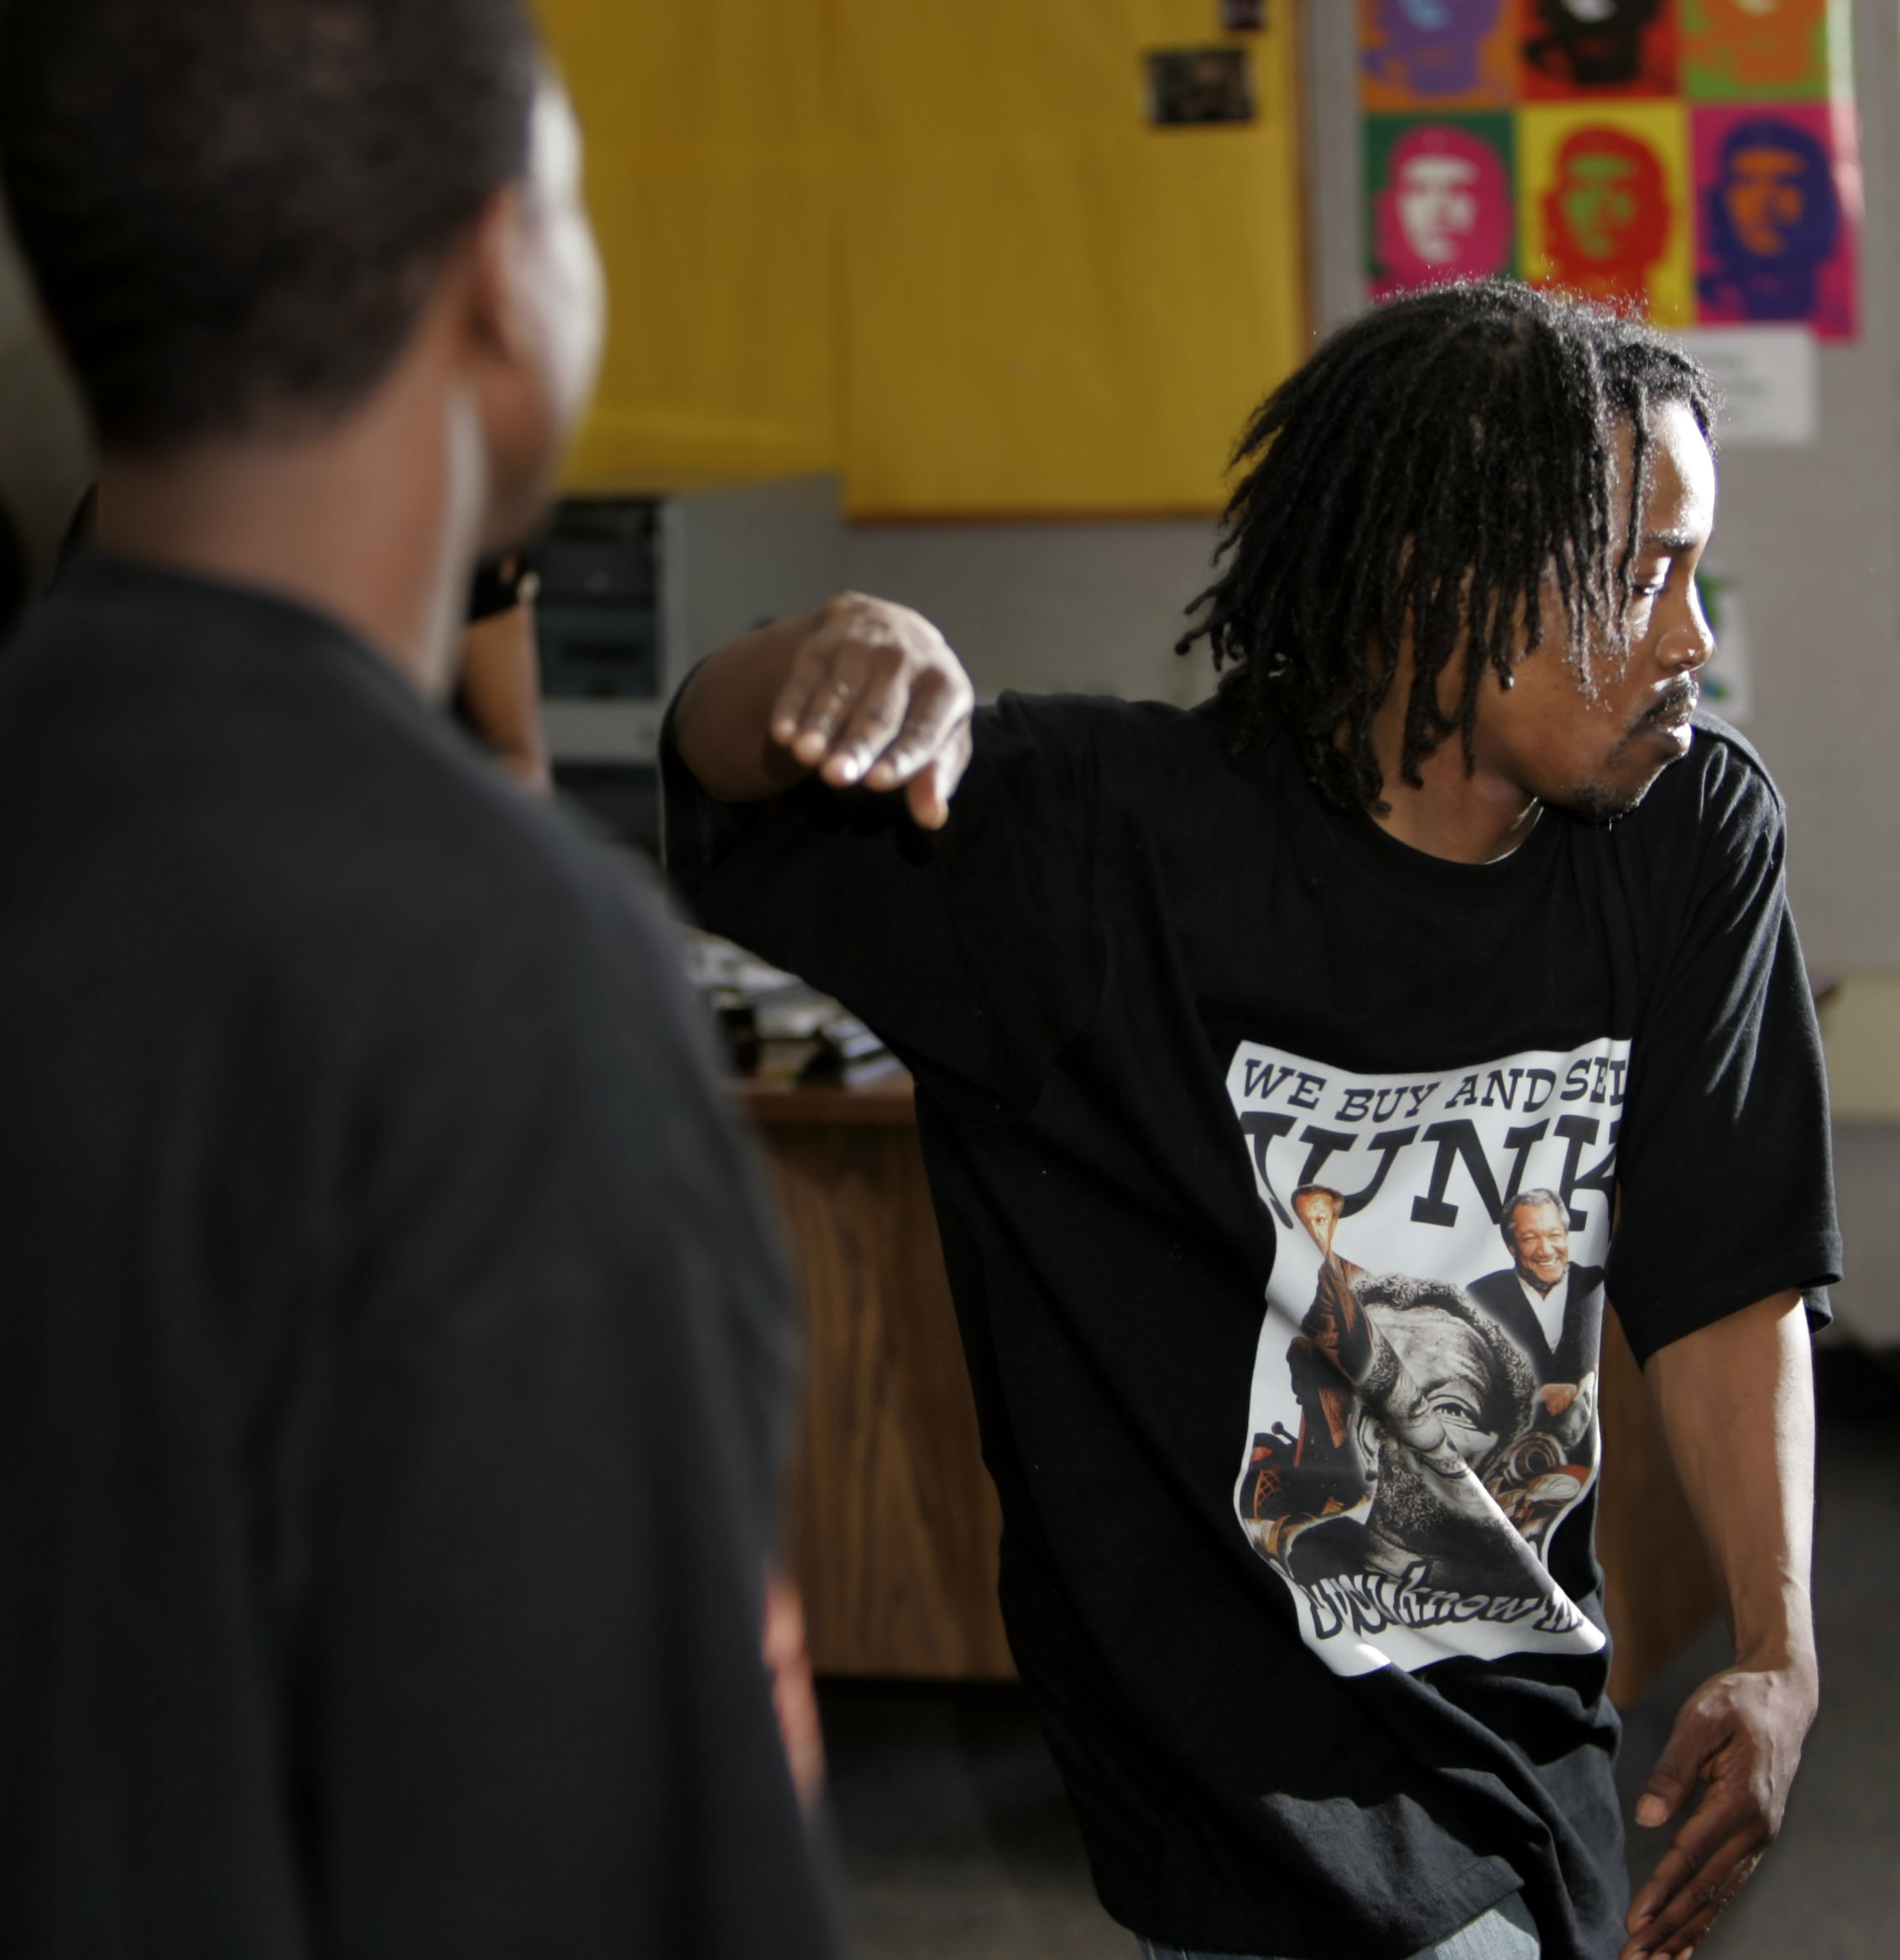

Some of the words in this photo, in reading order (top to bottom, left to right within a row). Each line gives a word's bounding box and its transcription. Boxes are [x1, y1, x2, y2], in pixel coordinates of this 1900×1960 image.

[1244, 1058, 1328, 1110] WE
[1334, 1081, 1442, 1123] BUY
[1444, 1067, 1558, 1113] AND
[1240, 1111, 1621, 1233] JUNK
[1395, 1561, 1542, 1628] know
